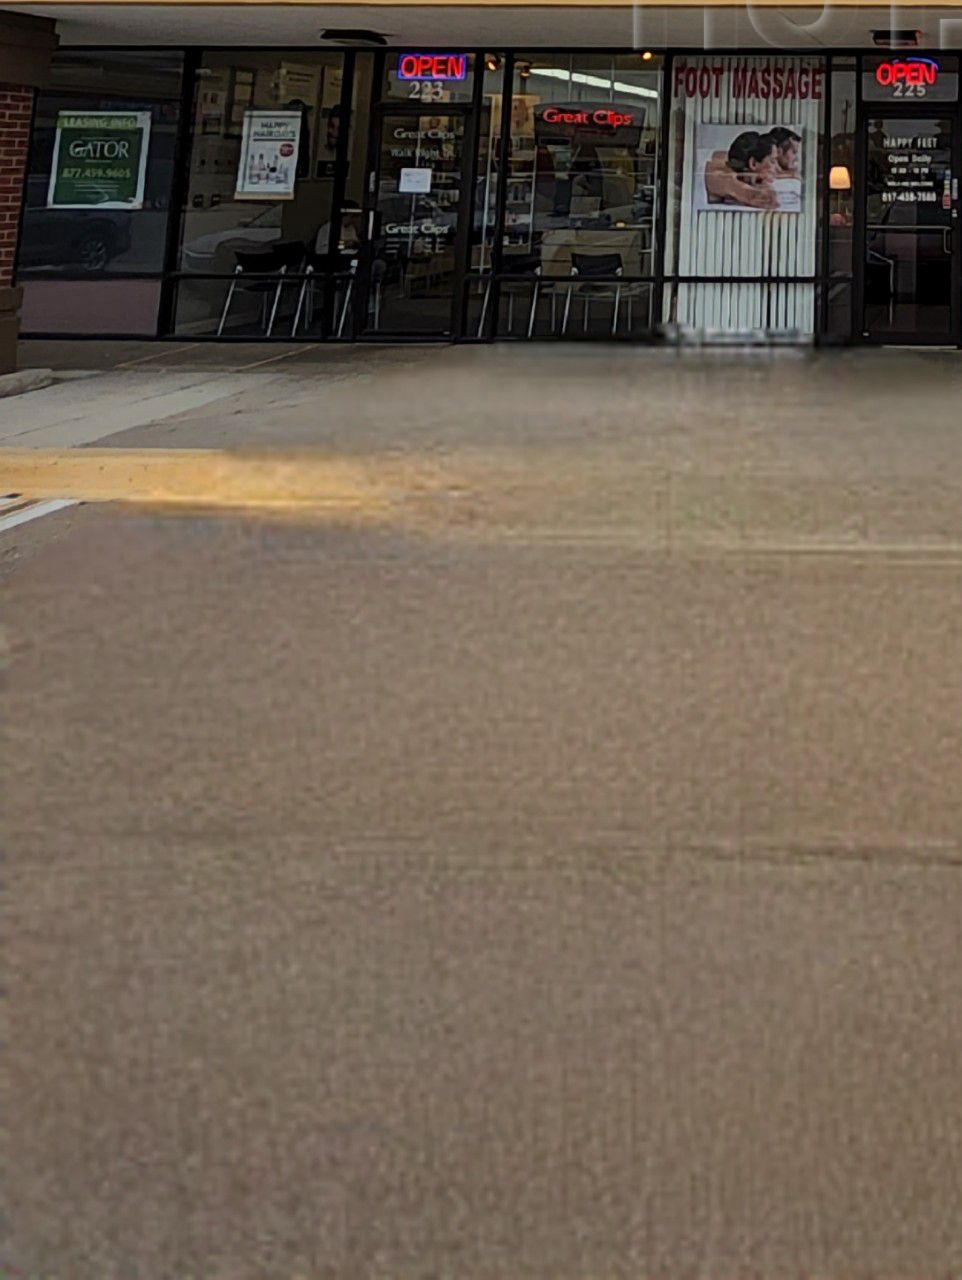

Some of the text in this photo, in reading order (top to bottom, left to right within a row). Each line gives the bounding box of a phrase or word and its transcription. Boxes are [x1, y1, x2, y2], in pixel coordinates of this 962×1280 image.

[401, 55, 464, 79] OPEN
[876, 63, 936, 86] OPEN
[674, 66, 825, 100] FOOT MASSAGE
[893, 82, 926, 97] 225
[543, 108, 633, 128] Great Clips
[69, 140, 130, 158] GATOR
[882, 136, 938, 148] HAPPY FEET
